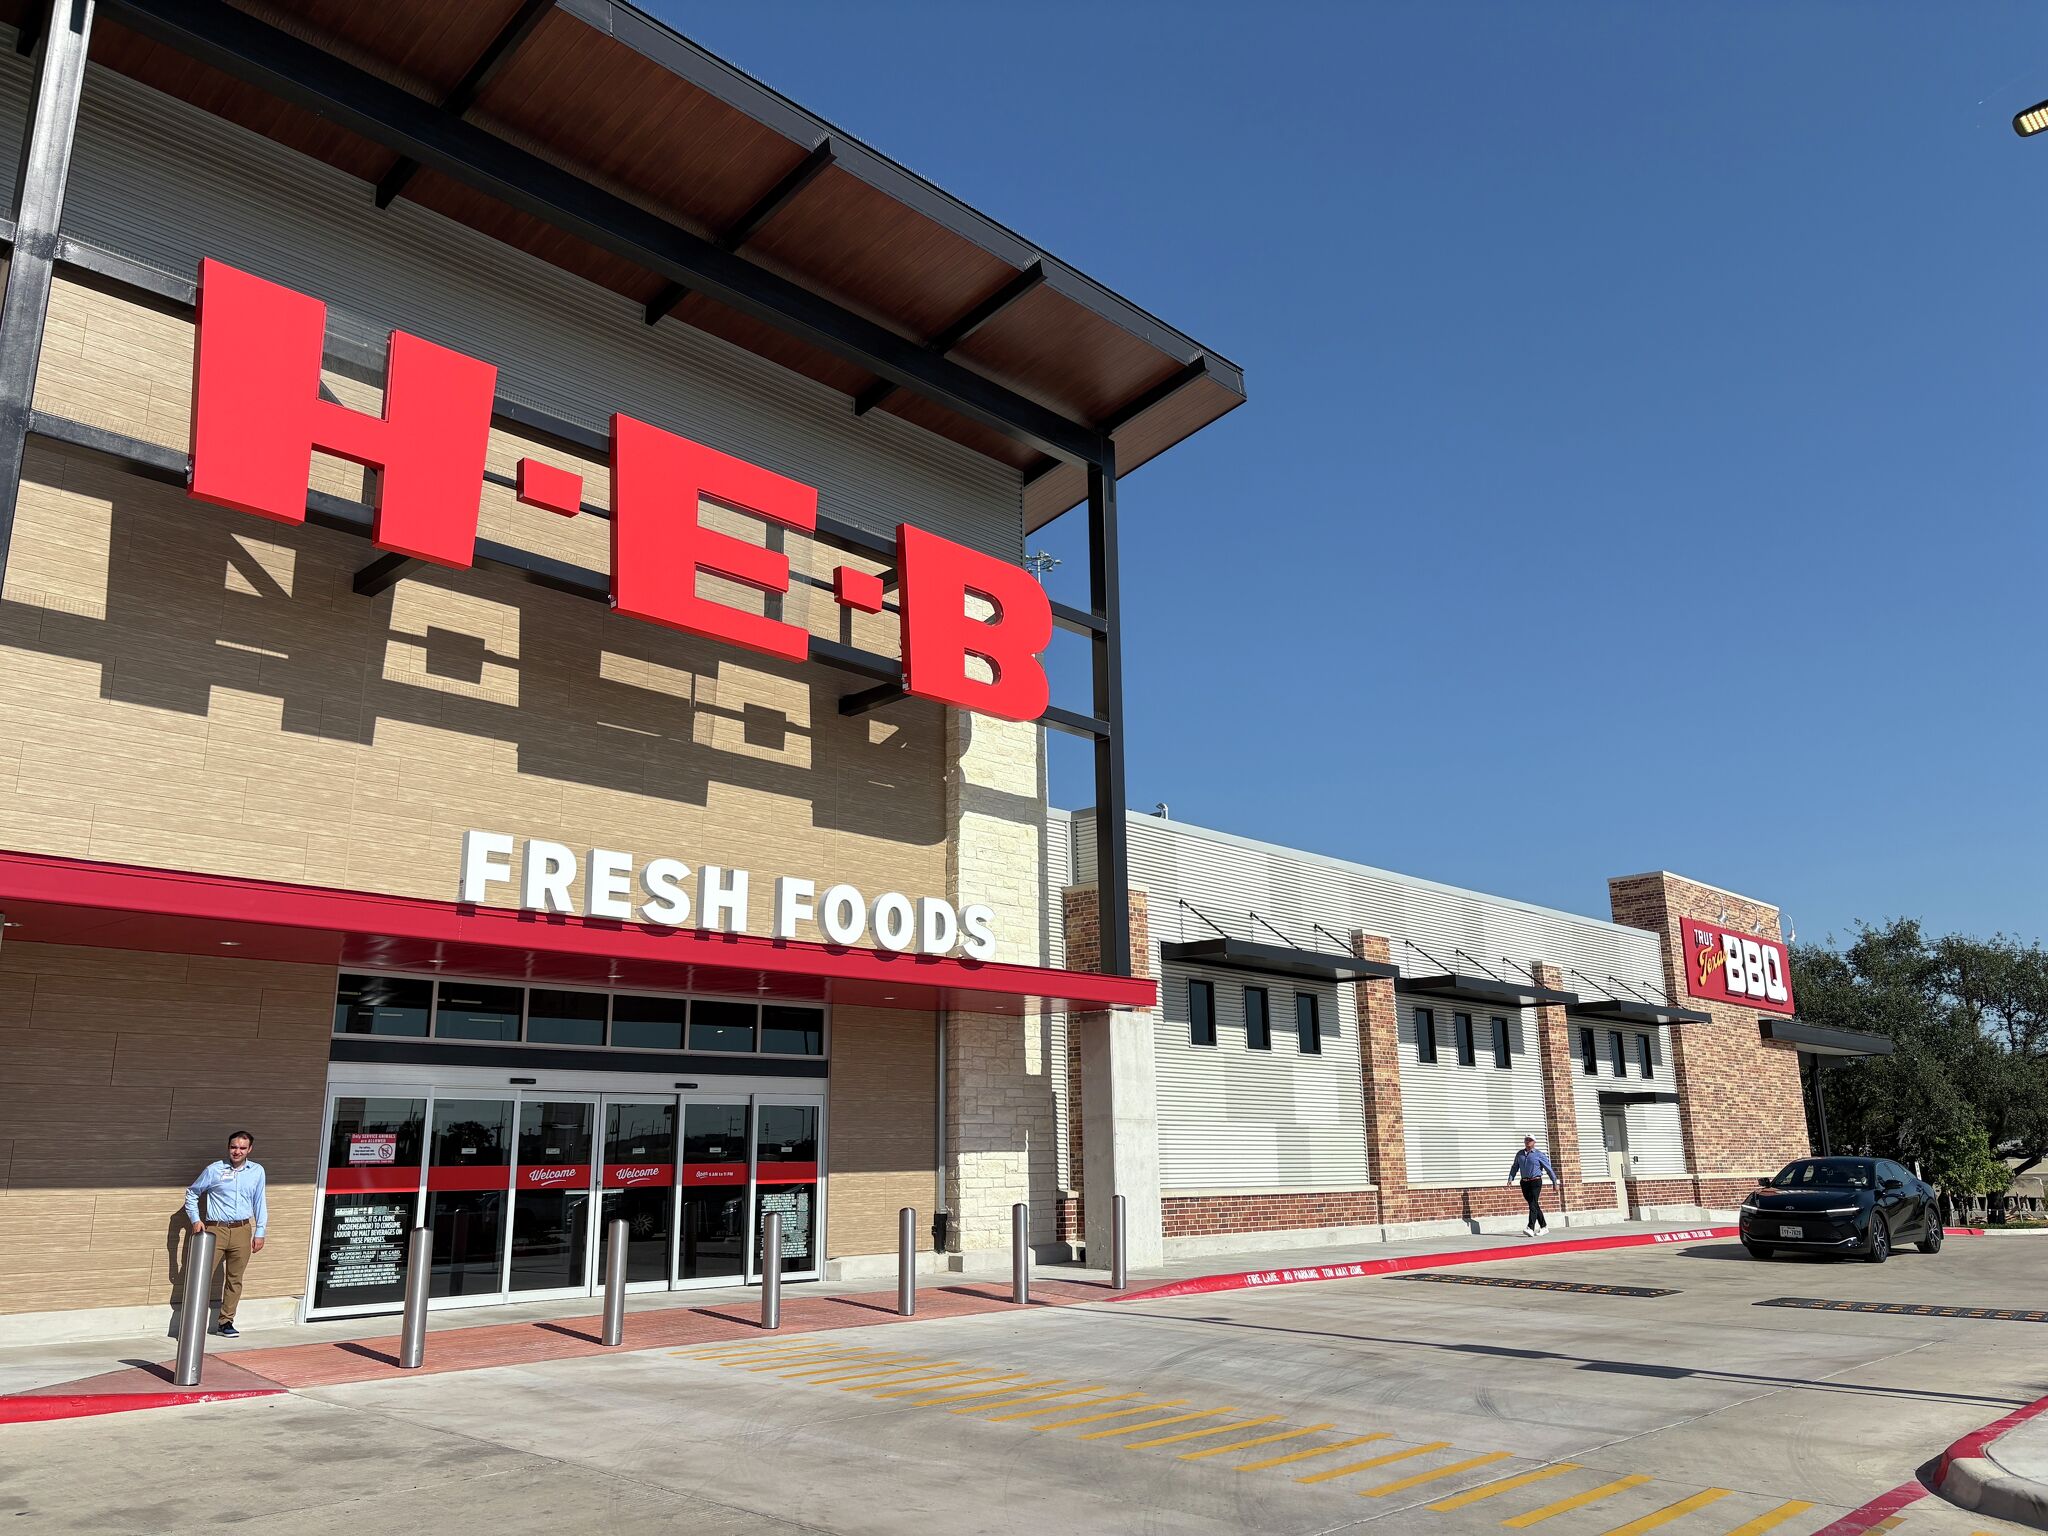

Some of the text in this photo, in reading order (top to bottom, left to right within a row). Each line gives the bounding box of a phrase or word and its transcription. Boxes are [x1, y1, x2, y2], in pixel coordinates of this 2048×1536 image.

[461, 829, 997, 960] FRESH FOODS
[1694, 929, 1714, 946] TRUE
[1699, 946, 1728, 987] Texas
[1721, 933, 1788, 1002] BBQ
[528, 1168, 576, 1181] Welcome
[616, 1167, 660, 1180] Welcome
[333, 1230, 351, 1238] LIQUOR
[337, 1222, 374, 1231] (MISDEMEANOR)
[380, 1221, 401, 1229] CONSUME
[1246, 1274, 1263, 1285] FIRE
[1282, 1271, 1293, 1280] NO
[1293, 1268, 1320, 1280] PARKING
[1321, 1267, 1334, 1277] TOW
[1334, 1266, 1348, 1276] AWAY
[1348, 1265, 1365, 1275] ZONE
